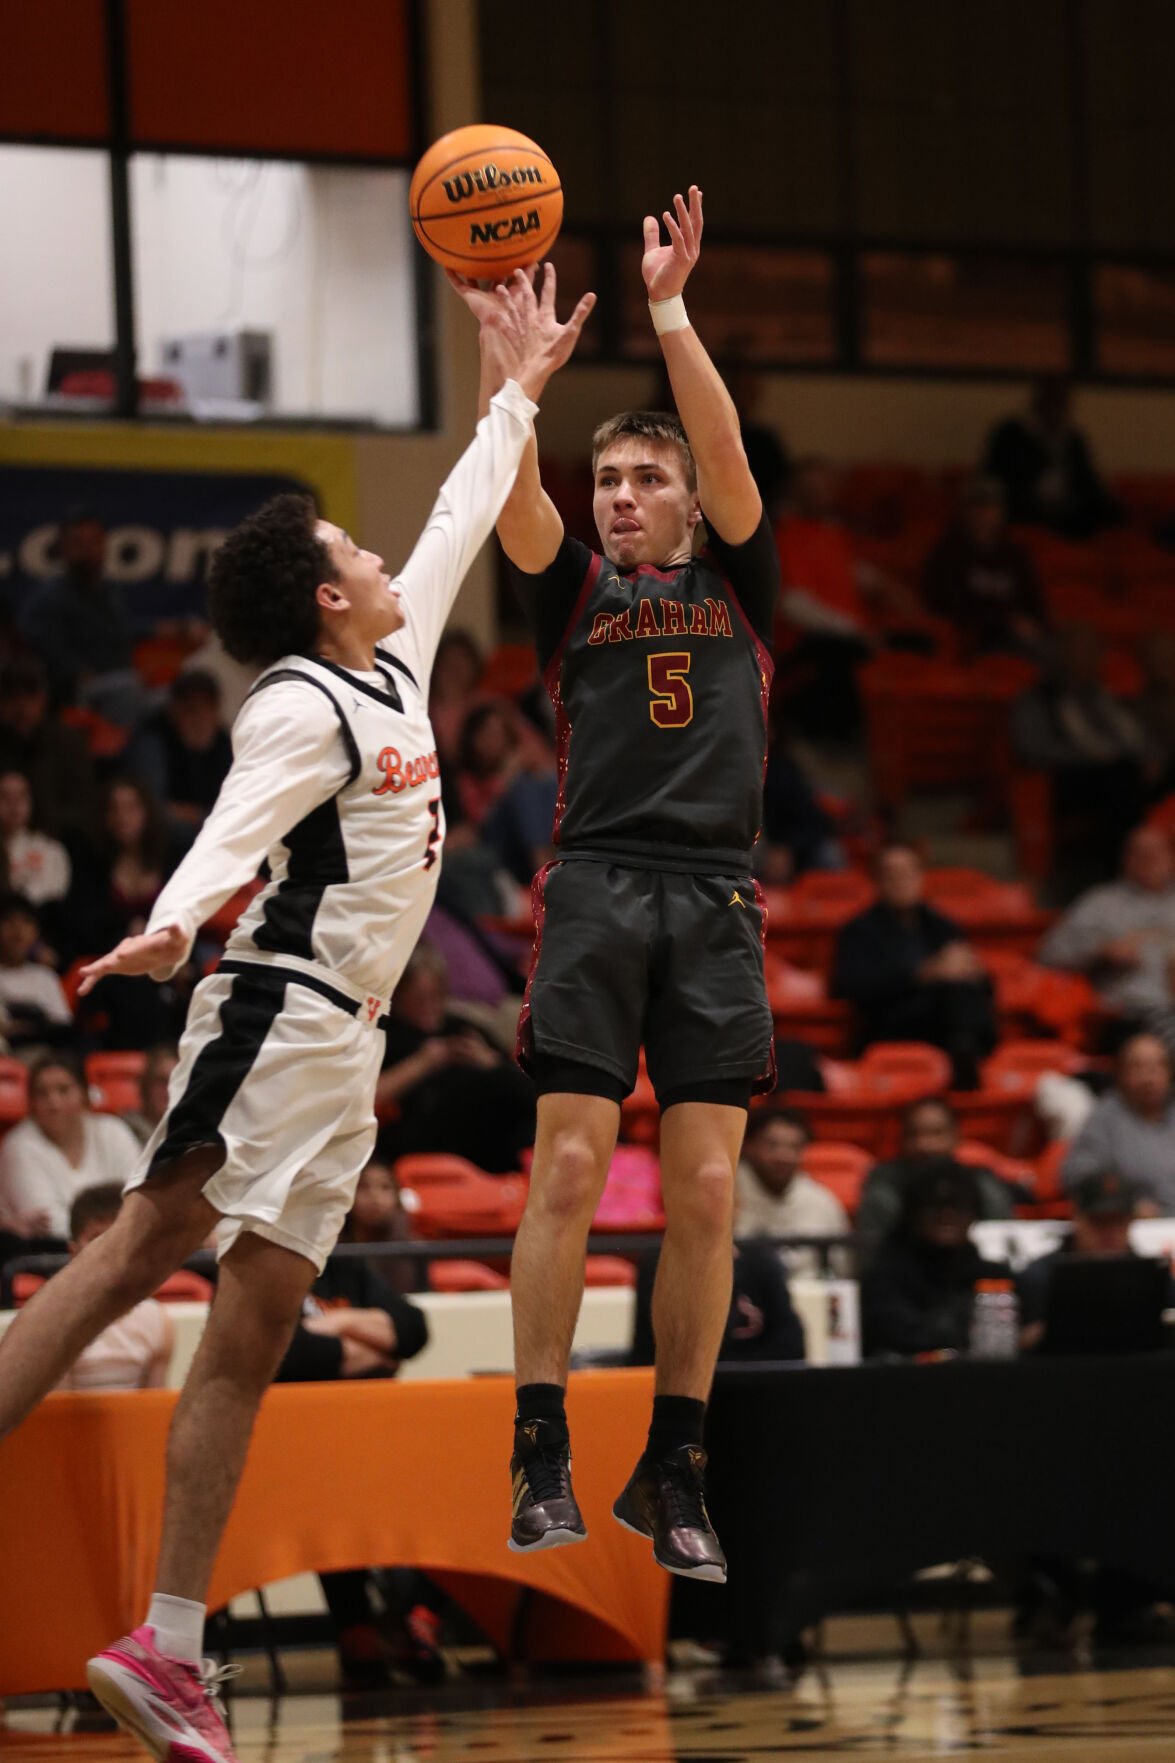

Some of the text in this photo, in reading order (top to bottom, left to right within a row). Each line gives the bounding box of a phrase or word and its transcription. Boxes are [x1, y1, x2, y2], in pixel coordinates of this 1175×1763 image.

[442, 164, 543, 203] Wilson
[469, 210, 541, 244] NCAA
[587, 597, 734, 646] GRAHAM
[647, 651, 694, 728] 5
